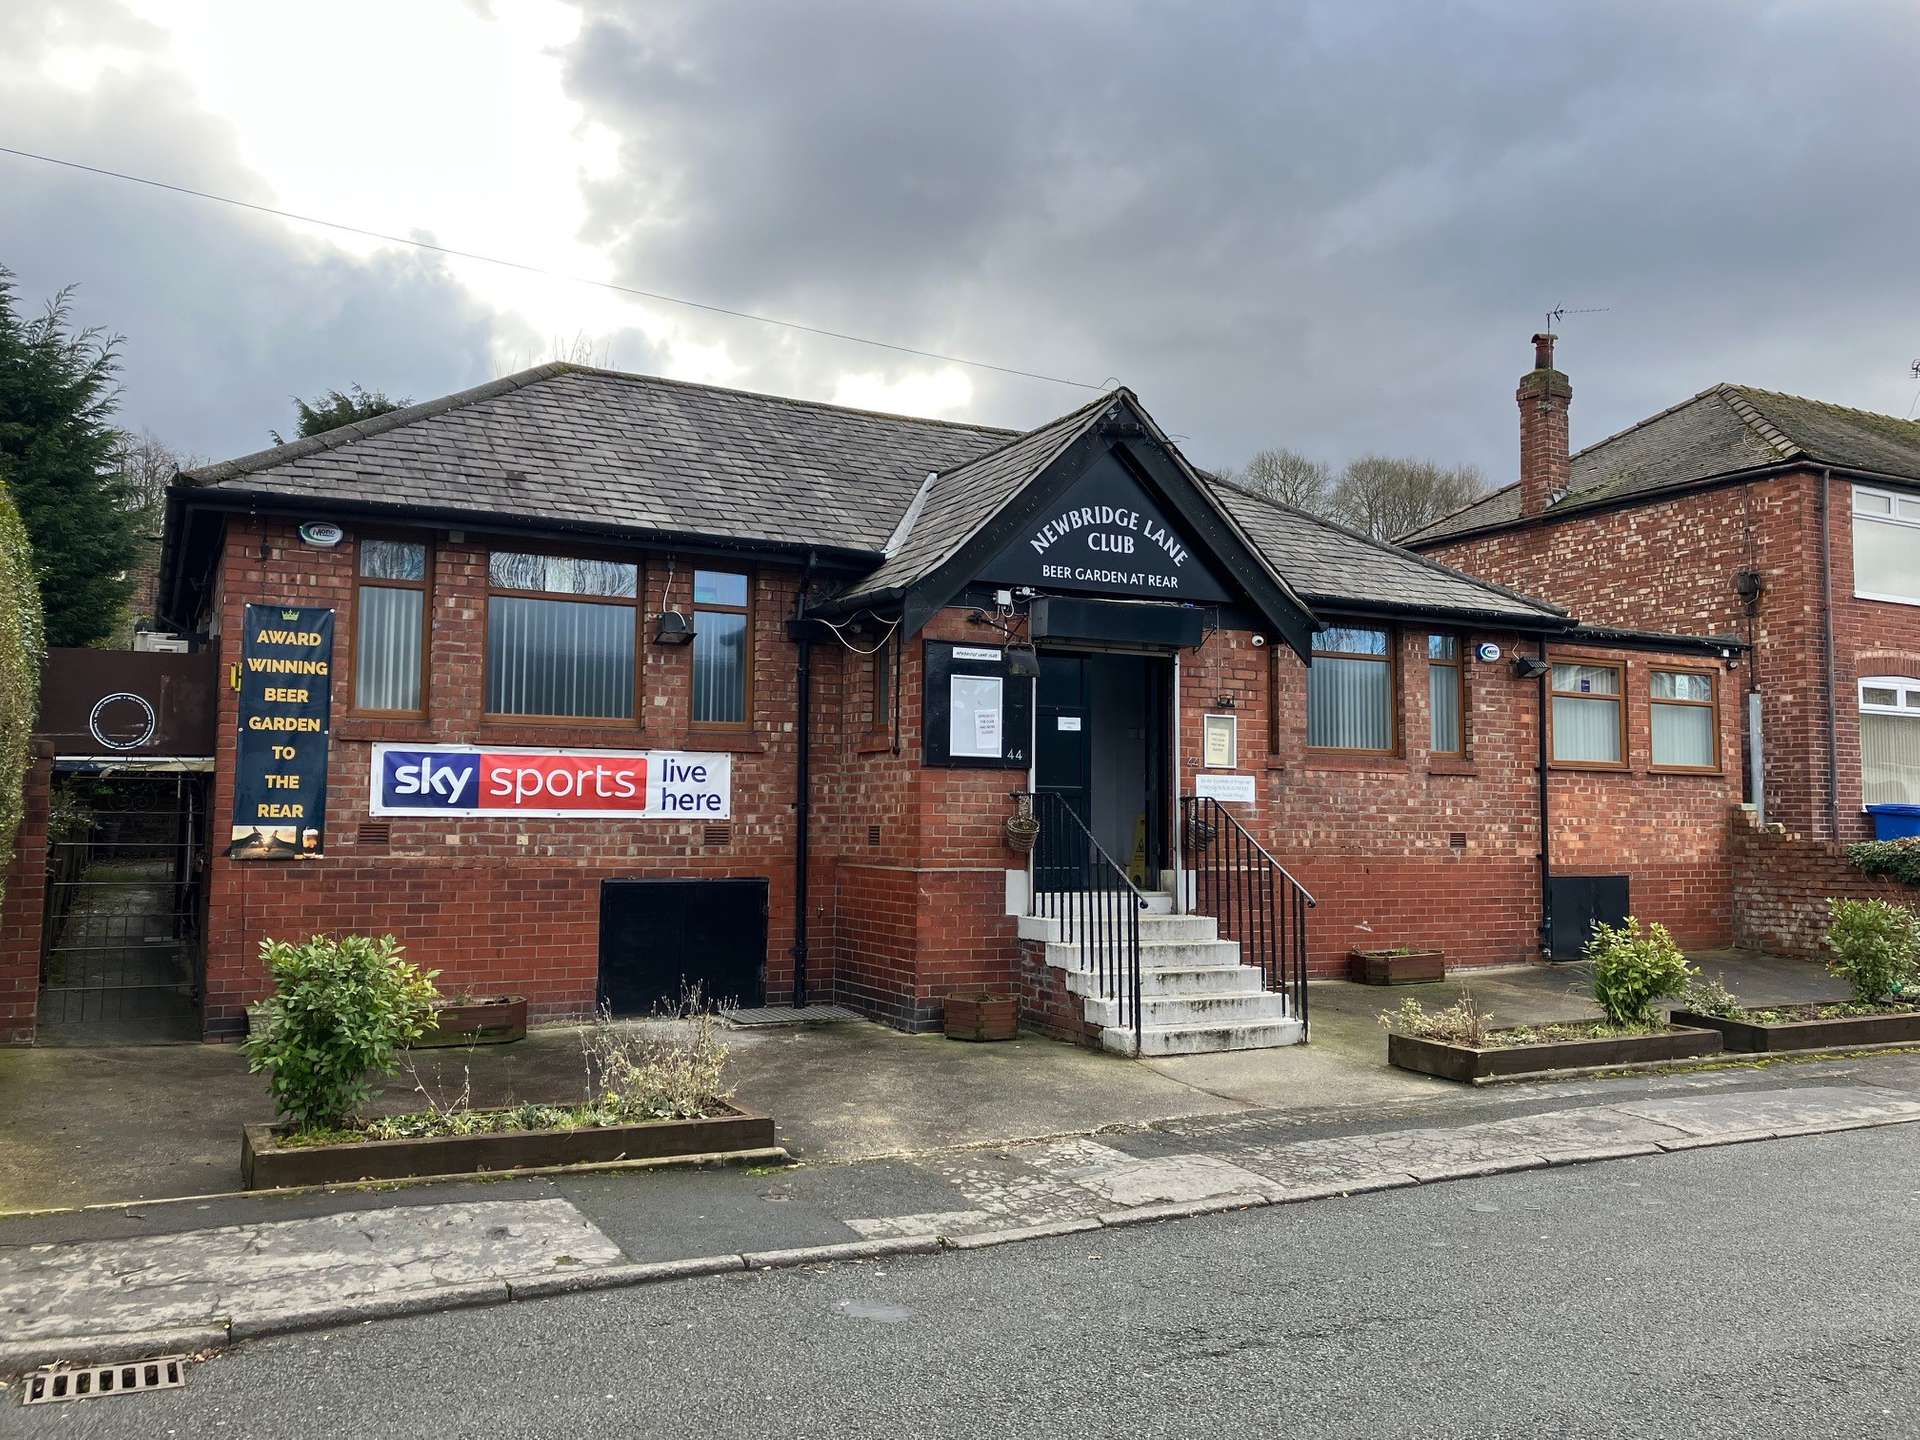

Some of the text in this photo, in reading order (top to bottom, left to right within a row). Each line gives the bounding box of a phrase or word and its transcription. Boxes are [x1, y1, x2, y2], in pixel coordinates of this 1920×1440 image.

[1030, 505, 1189, 567] NEWBRIDGE LANE
[1087, 532, 1135, 554] CLUB
[1042, 564, 1178, 589] BEER GARDEN AT REAR
[257, 629, 322, 646] AWARD
[248, 658, 328, 676] WINNING
[264, 688, 309, 703] BEER
[248, 716, 321, 732] GARDEN
[271, 745, 296, 760] TO
[1007, 748, 1023, 760] 44
[662, 758, 708, 783] live
[265, 775, 300, 789] THE
[394, 756, 636, 805] sky sports
[661, 788, 722, 812] here
[257, 803, 304, 818] REAR
